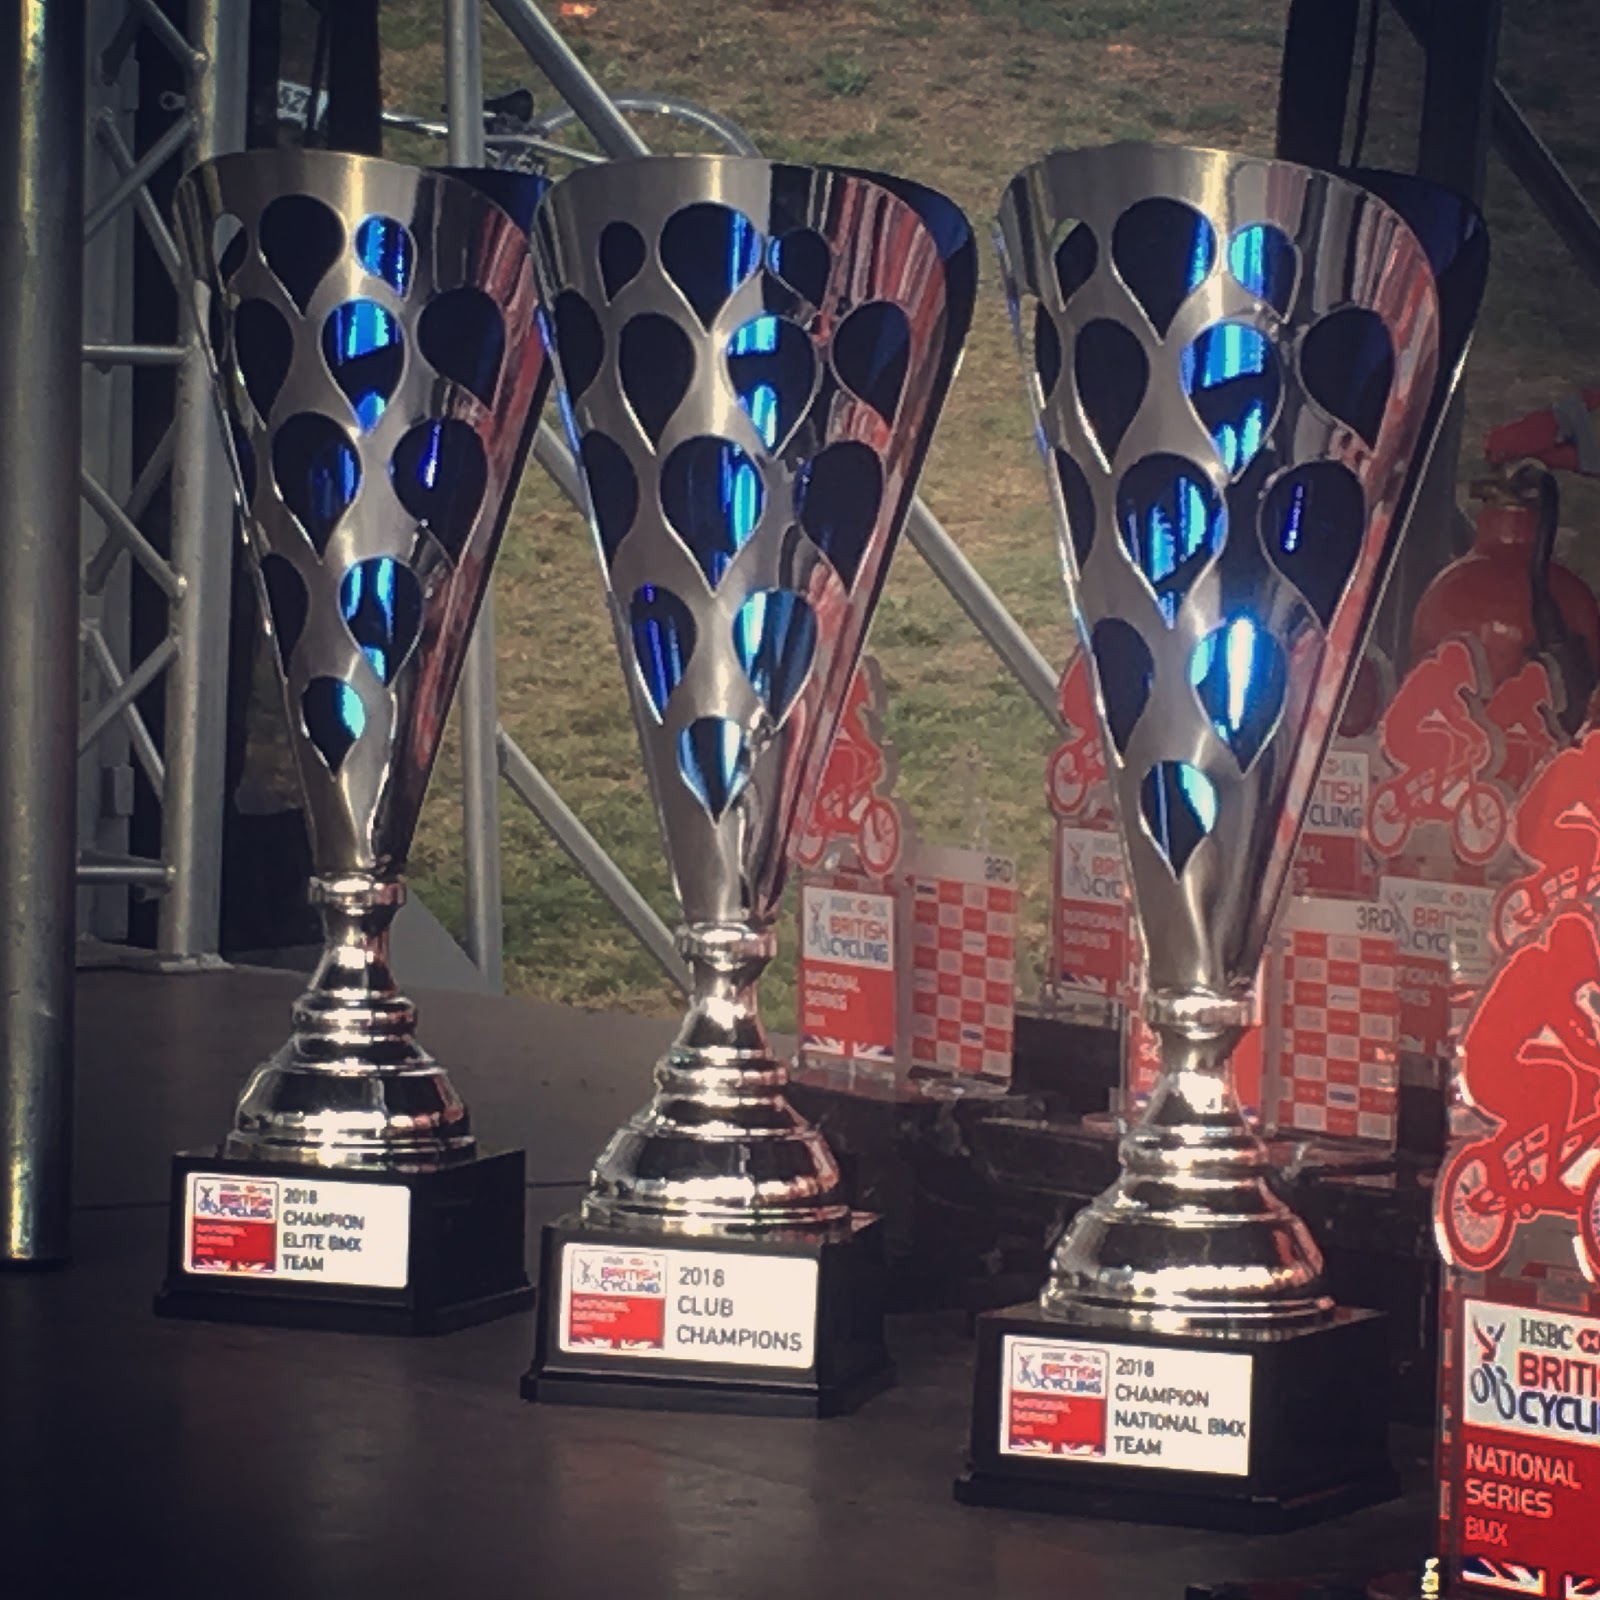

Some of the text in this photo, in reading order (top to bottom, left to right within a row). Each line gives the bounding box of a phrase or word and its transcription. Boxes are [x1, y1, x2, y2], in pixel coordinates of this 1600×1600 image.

[1319, 779, 1362, 804] TISH
[1309, 803, 1362, 829] CLING
[830, 915, 889, 941] BRITISH
[1356, 906, 1393, 933] 3RD
[831, 936, 889, 963] CYCLING
[283, 1187, 318, 1205] 2018
[283, 1209, 365, 1230] CHAMPION
[283, 1232, 362, 1252] ELITE BMX
[282, 1253, 324, 1271] TEAM
[679, 1266, 725, 1287] 2018
[677, 1296, 734, 1318] CLUB
[677, 1324, 802, 1352] CHAMPIONS
[1520, 1317, 1574, 1351] HSBC
[1116, 1357, 1155, 1378] 2018
[1518, 1350, 1600, 1398] BRITI
[1115, 1383, 1209, 1408] CHAMPION
[1114, 1410, 1246, 1438] NATIONAL BMX
[1519, 1391, 1600, 1435] CYCLI
[1114, 1436, 1162, 1456] TEAM
[1465, 1442, 1582, 1490] NATIONAL
[1465, 1478, 1553, 1519] SERIES
[1465, 1515, 1508, 1547] BMX
